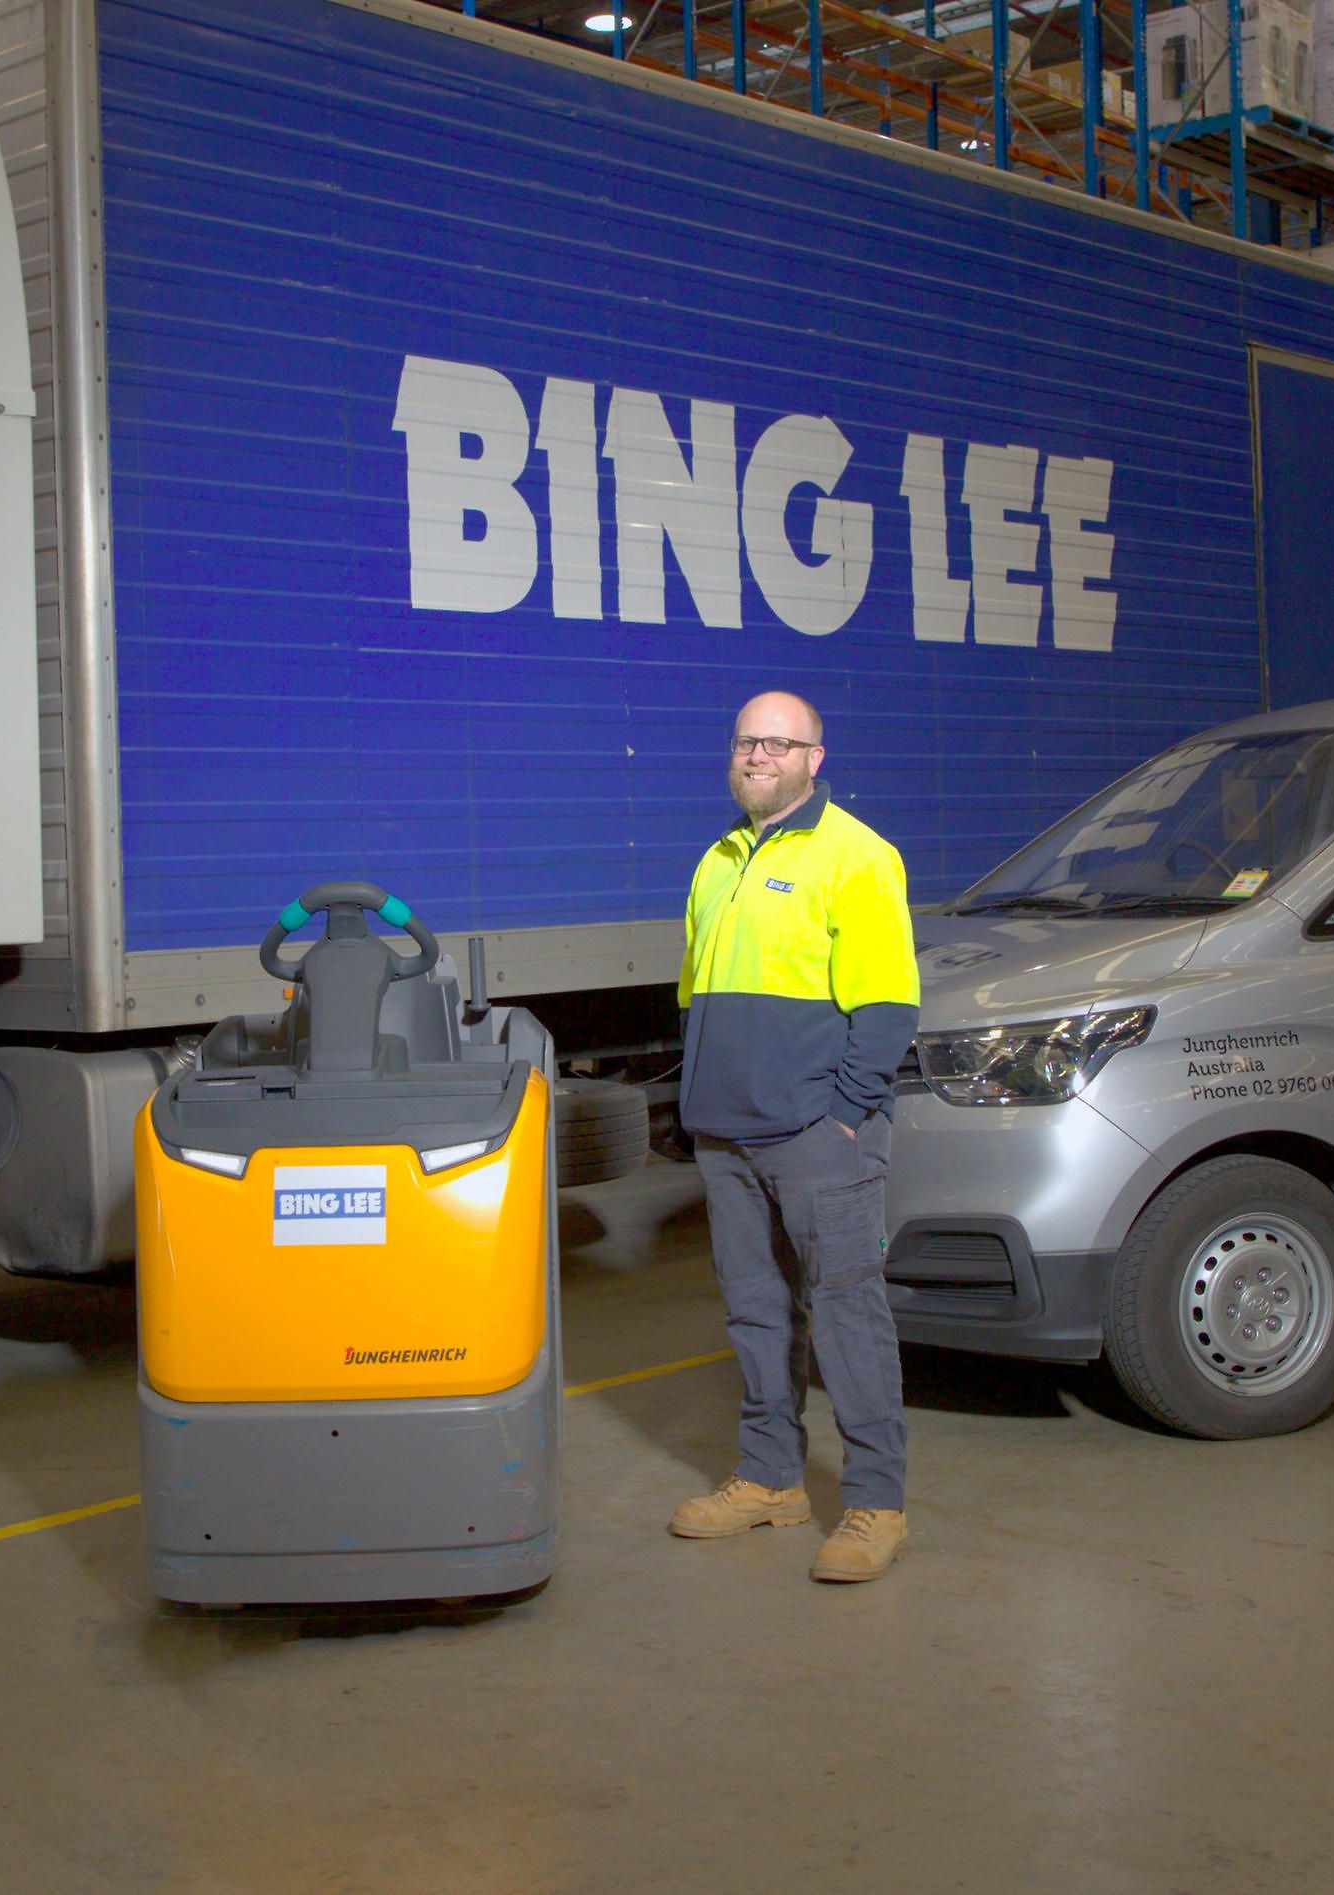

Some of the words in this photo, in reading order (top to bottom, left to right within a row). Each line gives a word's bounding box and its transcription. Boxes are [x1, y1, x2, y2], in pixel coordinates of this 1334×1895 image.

[392, 354, 873, 636] BING
[899, 432, 1117, 652] LEE
[1182, 1030, 1300, 1055] Jungheinrich
[1186, 1059, 1266, 1077] Australia
[1190, 1084, 1248, 1101] Phone
[1253, 1079, 1275, 1096] 02
[1277, 1075, 1317, 1094] 9760
[279, 1193, 340, 1216] BING
[343, 1192, 382, 1214] LEE
[344, 1347, 467, 1365] JUNGHEINRICH
